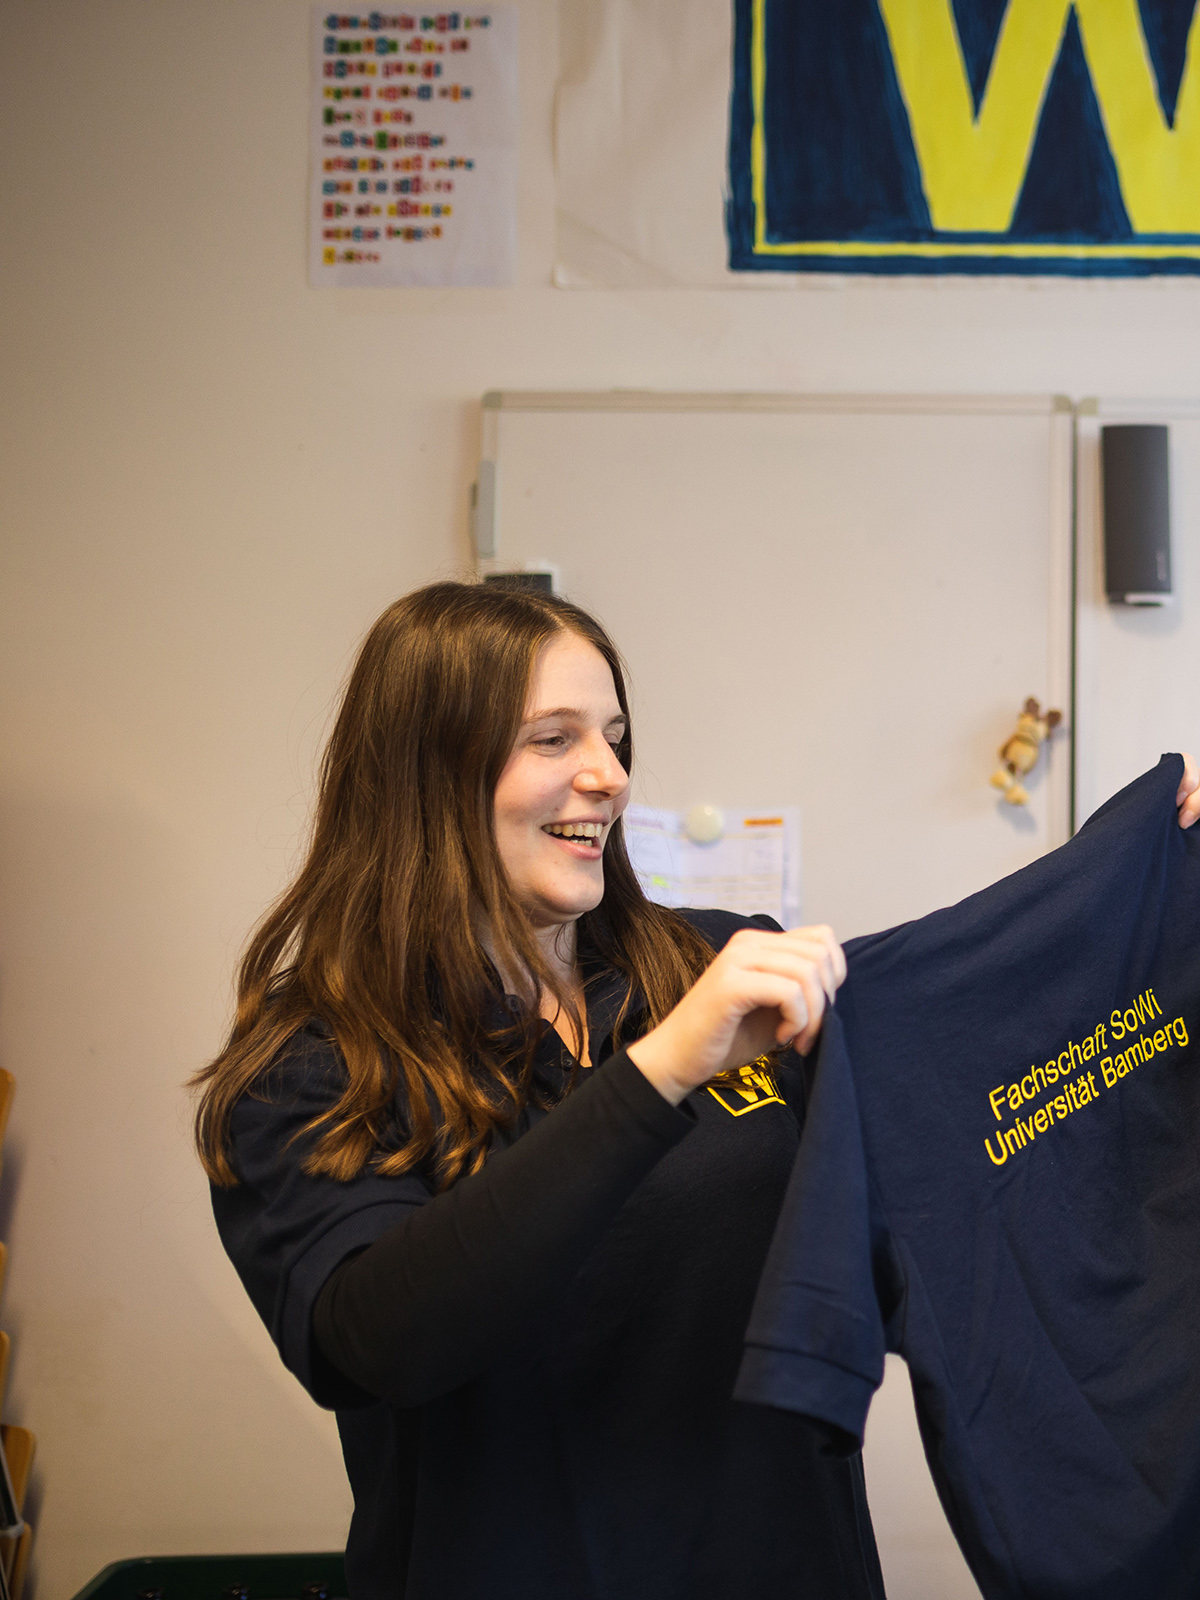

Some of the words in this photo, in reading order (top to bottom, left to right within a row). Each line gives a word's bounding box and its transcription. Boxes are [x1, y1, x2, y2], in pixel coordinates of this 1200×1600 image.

[984, 1070, 1100, 1166] Universität
[1099, 1016, 1189, 1089] Bamberg
[988, 1023, 1109, 1122] Fachschaft
[1110, 988, 1163, 1040] SoWi
